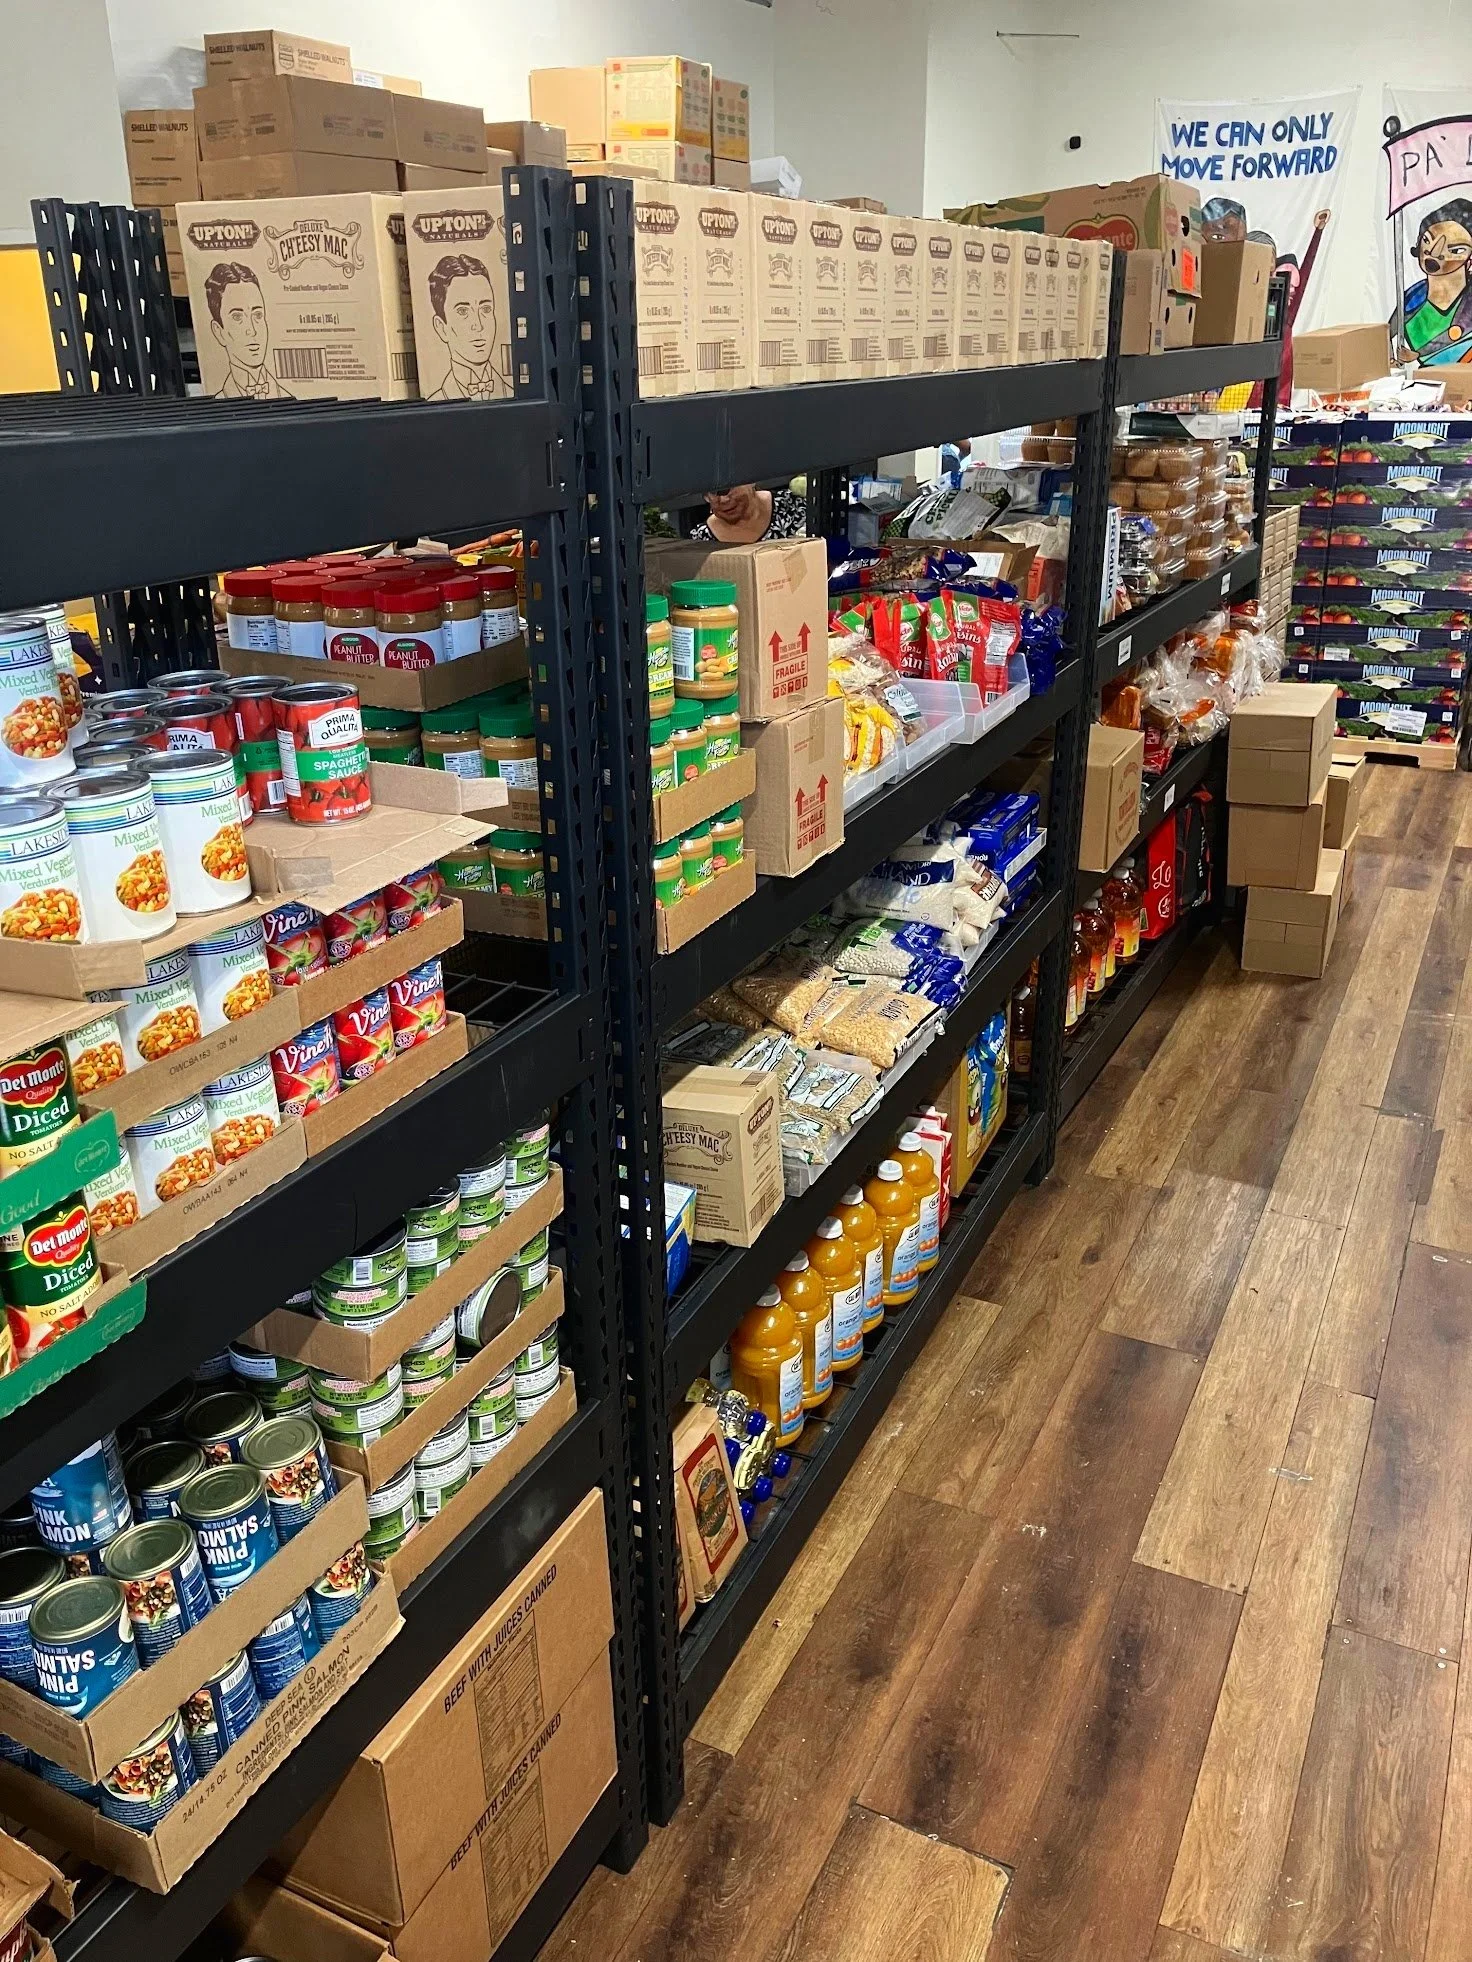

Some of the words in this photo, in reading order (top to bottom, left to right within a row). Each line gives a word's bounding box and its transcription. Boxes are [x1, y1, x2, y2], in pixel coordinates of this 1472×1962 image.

[209, 44, 234, 54] SHELLED
[236, 42, 265, 52] WALNUTS
[298, 50, 320, 60] SHELLED
[321, 53, 346, 66] WALNUTS
[131, 123, 157, 132] SHELLED
[158, 122, 189, 132] WALNUTS
[1172, 121, 1209, 148] WE
[1215, 120, 1265, 148] CAN
[1272, 112, 1334, 143] ONLY
[1162, 153, 1225, 181] MOVE
[1231, 145, 1337, 181] FORWARD
[300, 222, 324, 233] DELUXE
[430, 232, 479, 240] NATURALS
[280, 233, 321, 262] CH'EESY
[324, 236, 348, 260] MAC
[1393, 422, 1450, 438] MOONLIGHT
[1386, 466, 1444, 482] MOONLIGHT
[1382, 507, 1438, 524] MOONLIGHT
[1376, 550, 1432, 566] MOONLIGHT
[1370, 588, 1425, 606] MOONLIGHT
[1367, 627, 1421, 644] MOONLIGHT
[334, 644, 362, 656] PEANUT
[346, 653, 375, 664] BUTTER
[388, 650, 418, 662] PEANUT
[402, 659, 431, 670] BUTTER
[776, 660, 806, 680] FRAGILE
[1362, 664, 1416, 682] MOONLIGHT
[326, 714, 355, 728] PRIMA
[168, 734, 198, 744] RIMA
[328, 764, 362, 780] SAUCE
[201, 800, 232, 818] Mixed
[799, 808, 824, 832] FRAGILE
[114, 829, 150, 848] Mixed
[0, 862, 42, 884] Mixed
[19, 872, 60, 891] Verduras
[222, 952, 256, 969] Mixed
[136, 986, 174, 1006] Mixed
[78, 1030, 112, 1048] Verduras
[1, 1077, 27, 1094] Del
[28, 1059, 66, 1087] Monte
[25, 1085, 54, 1101] Quality
[206, 1097, 244, 1112] Mixed
[223, 1103, 258, 1117] Verduras
[12, 1096, 70, 1133] Diced
[30, 1120, 64, 1136] TOMATOES
[678, 1124, 700, 1133] DELUXE
[8, 1149, 27, 1160] NO
[28, 1140, 54, 1156] SALT
[154, 1132, 192, 1151] Mixed
[698, 1134, 720, 1153] MAC
[94, 1182, 126, 1200] Verduras
[462, 1203, 488, 1213] DUCHESS
[31, 1238, 57, 1256] Del
[56, 1216, 88, 1245] Monte
[55, 1242, 82, 1260] Quality
[42, 1251, 94, 1292] Diced
[60, 1274, 89, 1294] TOMATOES
[40, 1306, 58, 1318] NO
[59, 1296, 82, 1311] SALT
[34, 1506, 68, 1526] PINK
[206, 1540, 249, 1565] PINK
[444, 1674, 466, 1715] BEEF
[468, 1644, 492, 1682] WITH
[494, 1606, 523, 1652] JUICES
[524, 1564, 557, 1613] CANNED
[40, 1674, 78, 1694] PINK
[298, 1690, 324, 1718] SALMON
[324, 1675, 336, 1691] AND
[264, 1702, 286, 1729] DEEP
[286, 1683, 304, 1708] SEA
[216, 1770, 228, 1786] OZ
[236, 1722, 281, 1775] CANNED
[282, 1694, 306, 1722] PINK
[308, 1645, 350, 1694] SALMON
[450, 1834, 472, 1872] BEEF
[474, 1796, 498, 1837] WITH
[500, 1756, 528, 1804] JUICES
[530, 1712, 562, 1764] CANNED
